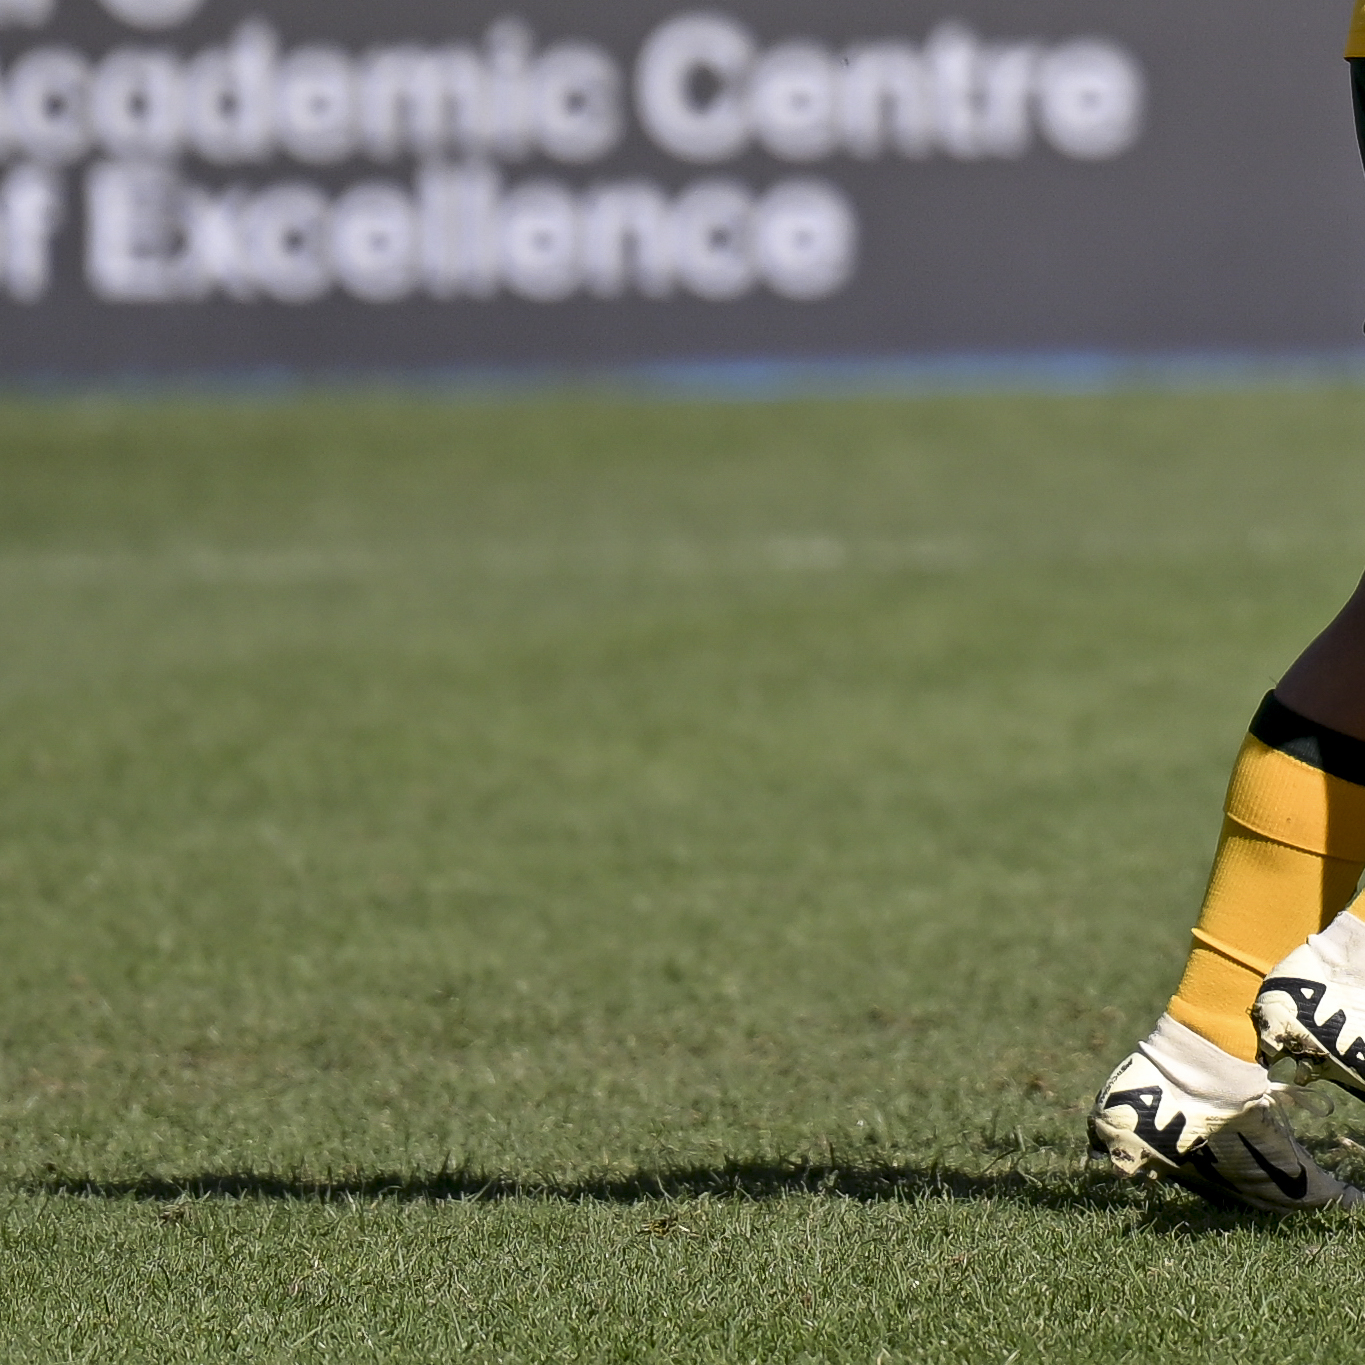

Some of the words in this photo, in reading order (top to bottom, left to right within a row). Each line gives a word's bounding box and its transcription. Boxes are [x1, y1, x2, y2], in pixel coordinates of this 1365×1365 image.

[0, 16, 624, 162] cademic
[635, 12, 1143, 160] Centre
[85, 162, 858, 302] Excellence
